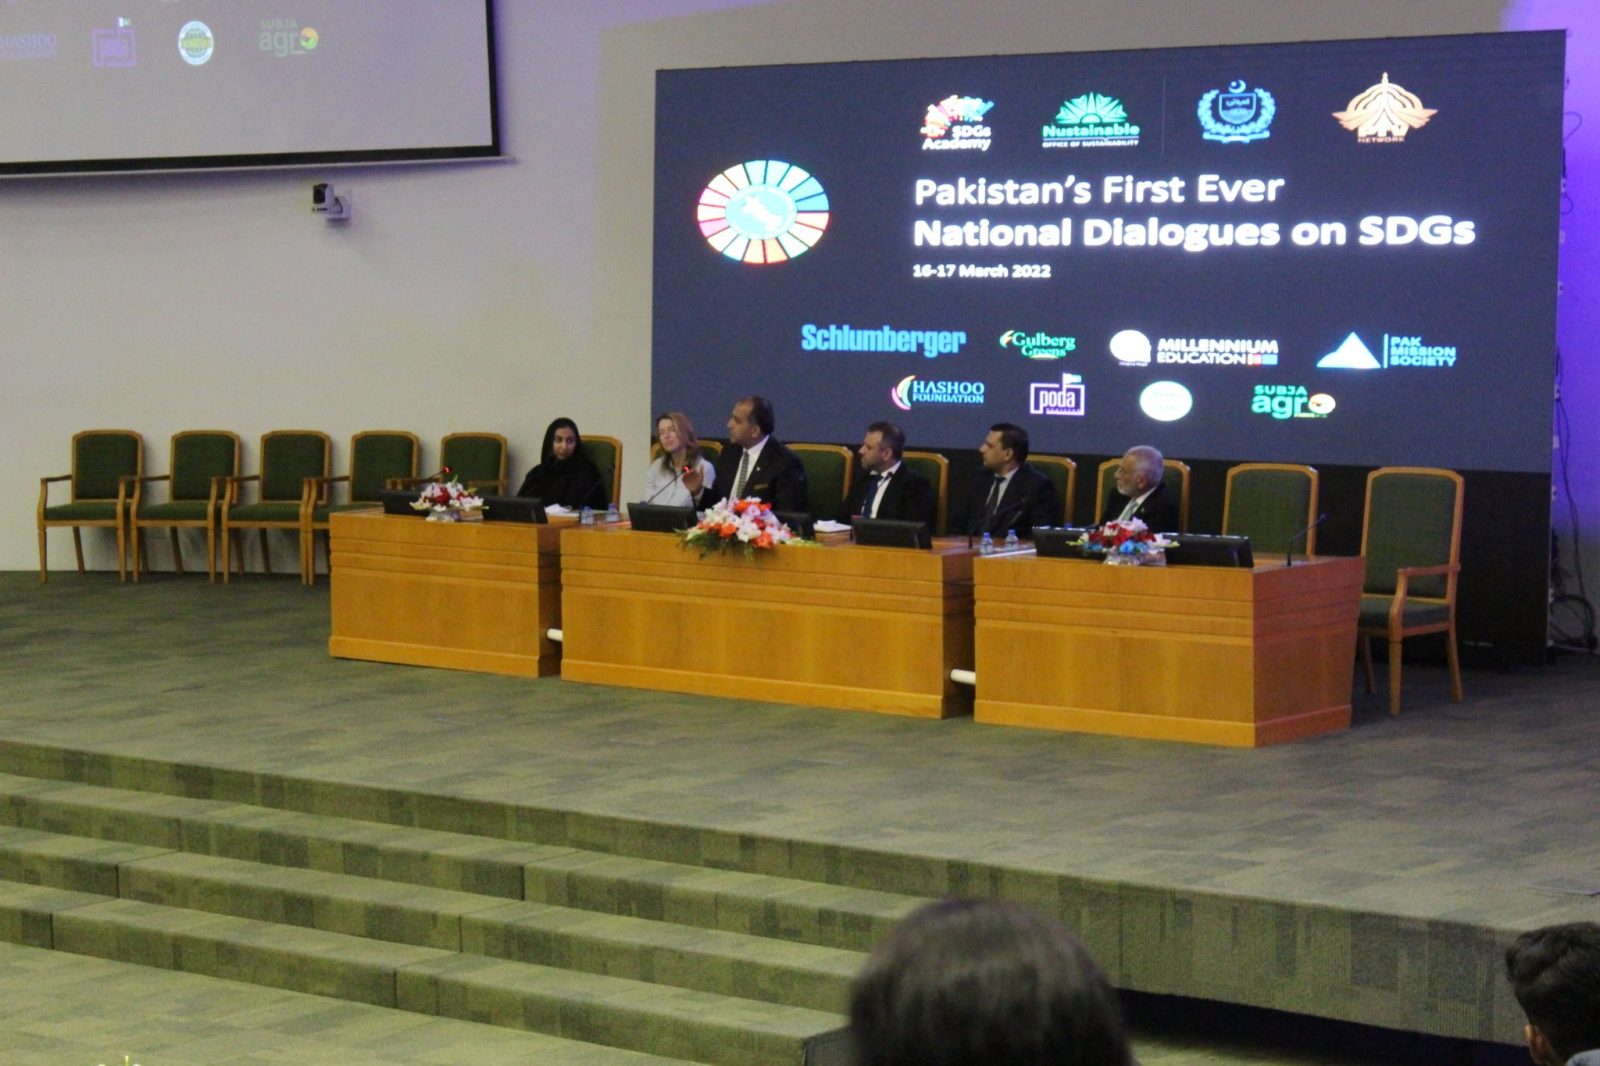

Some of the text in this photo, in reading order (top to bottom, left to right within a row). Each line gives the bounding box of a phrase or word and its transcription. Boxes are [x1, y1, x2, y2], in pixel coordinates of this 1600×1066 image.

[952, 125, 991, 138] SDGs
[922, 138, 992, 151] Academy
[1042, 139, 1139, 148] OFFICE OF SUSTAINABILITY
[1102, 175, 1186, 204] First
[1196, 174, 1285, 203] Ever
[913, 214, 1477, 253] National Dialogues on SDGs
[912, 263, 1052, 279] 16-17 March 2022
[801, 323, 967, 358] Schlumberger
[1011, 332, 1077, 351] Gulberg
[1157, 337, 1279, 354] MILLENNIUM
[1390, 335, 1422, 347] PAK
[1156, 351, 1247, 364] EDUCATION
[1390, 346, 1457, 356] MISSION
[1390, 355, 1457, 367] SOCIETY
[912, 379, 986, 396] HASHOO
[1254, 384, 1309, 395] SUBJA
[911, 393, 985, 404] FOUNDATION
[1039, 388, 1077, 415] poda
